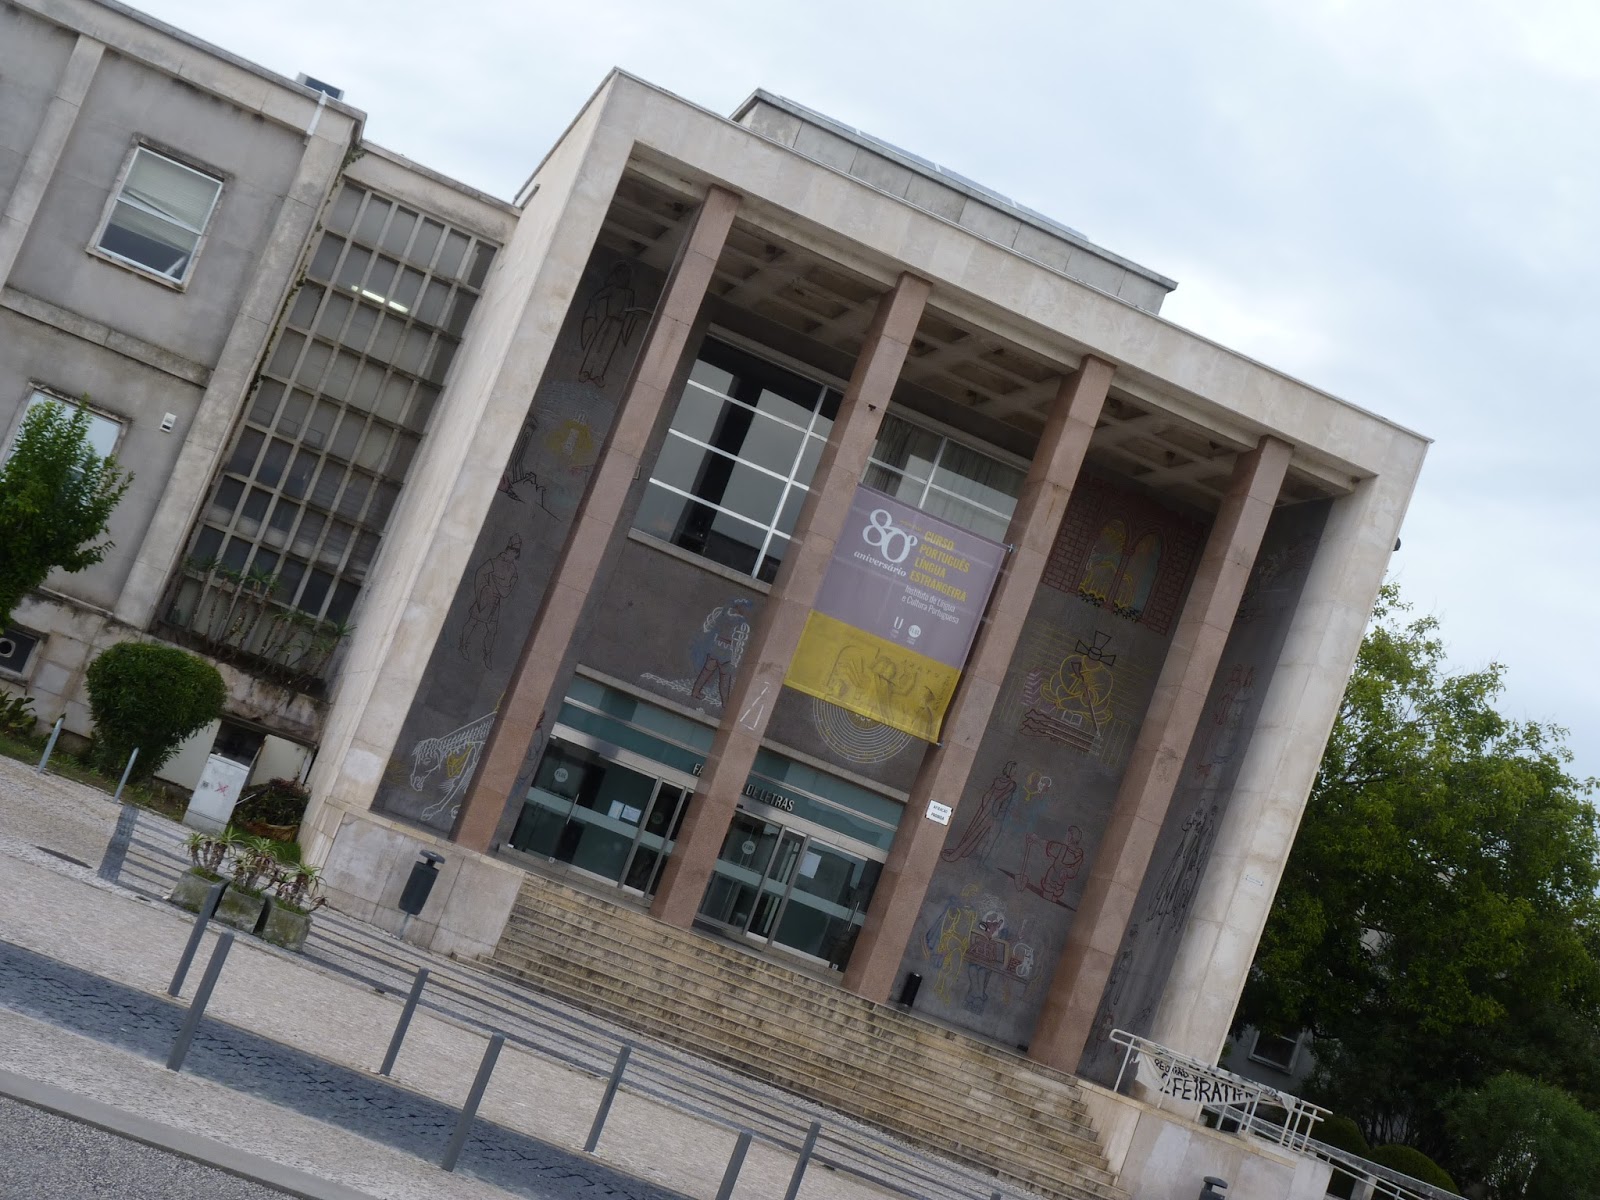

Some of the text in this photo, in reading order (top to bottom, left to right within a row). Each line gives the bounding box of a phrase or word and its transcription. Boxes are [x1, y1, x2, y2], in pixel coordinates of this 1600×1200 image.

[924, 531, 955, 551] CURSO
[853, 550, 907, 577] aniversário
[914, 557, 947, 578] LÍNGUA
[919, 544, 970, 573] PORTUGUÊS
[904, 585, 956, 612] Instituto de Língua
[909, 570, 967, 602] ESTRANGEIRA
[906, 596, 928, 611] Cultura
[927, 605, 960, 624] Portuguesa
[746, 783, 795, 812] DE LETRAS
